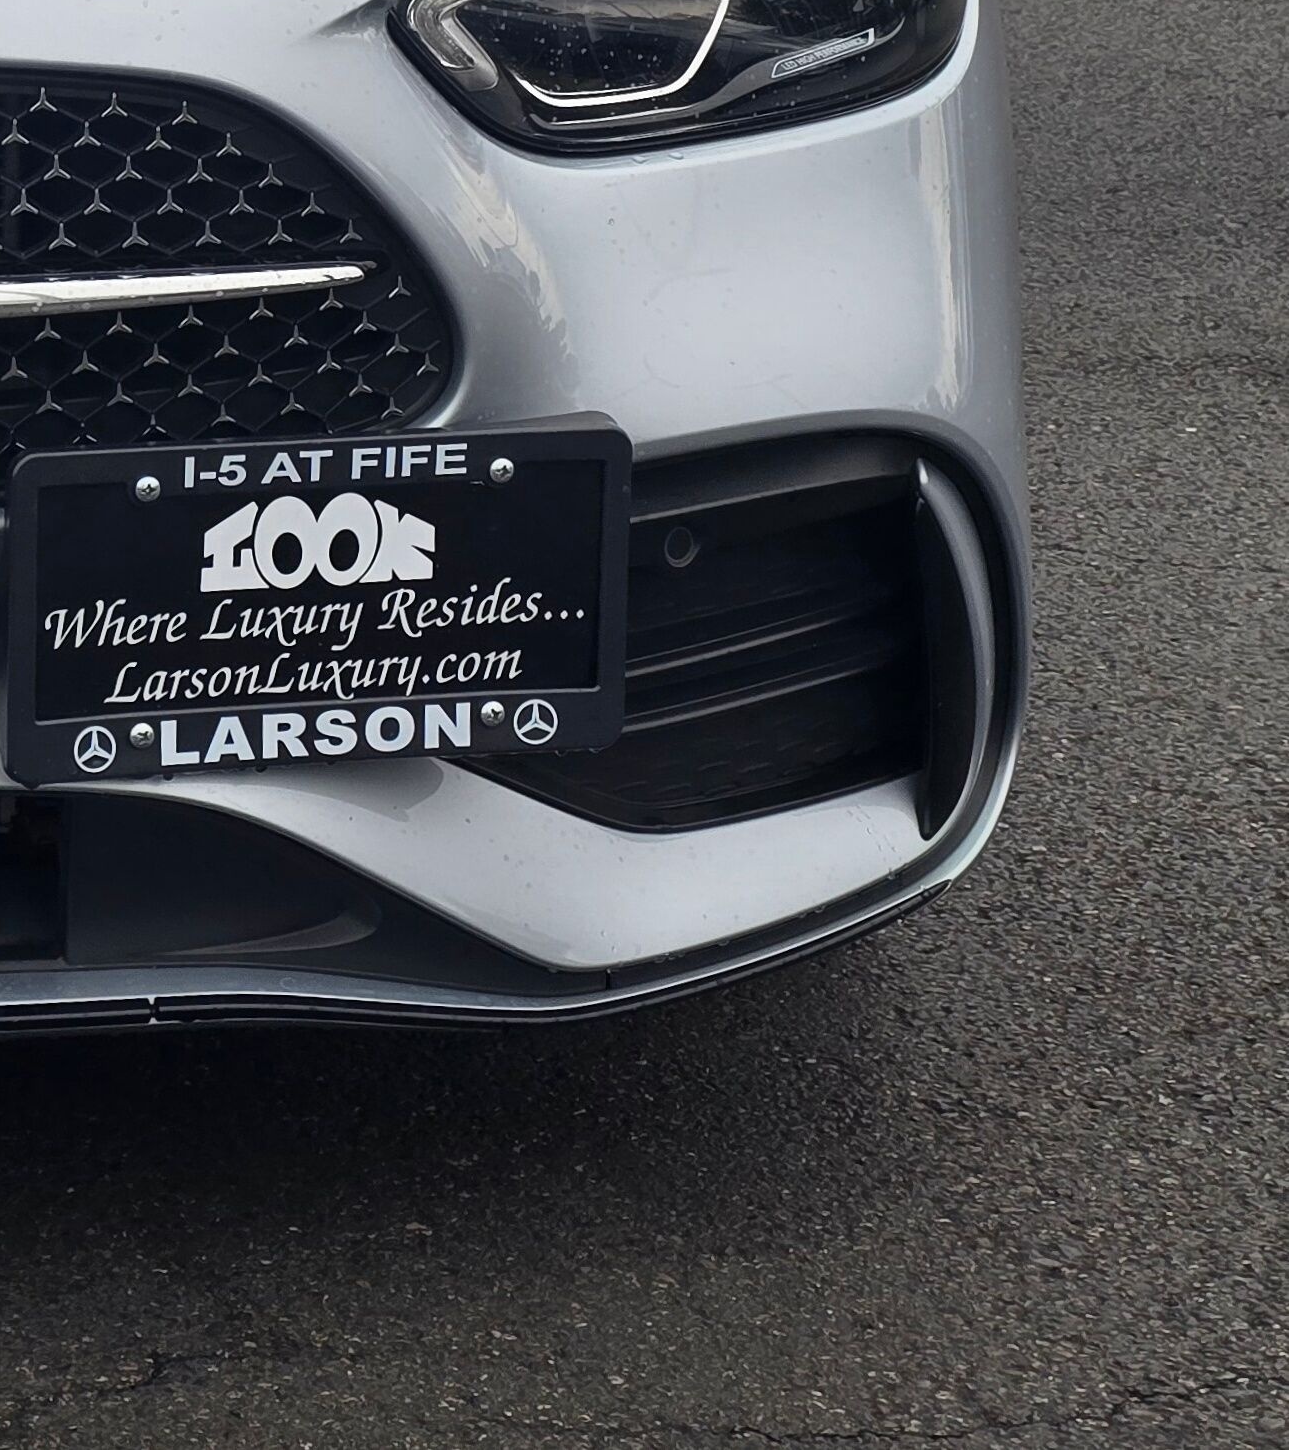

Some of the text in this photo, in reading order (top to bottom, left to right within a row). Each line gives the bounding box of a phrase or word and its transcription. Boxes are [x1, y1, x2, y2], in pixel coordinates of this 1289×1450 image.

[183, 442, 468, 488] I-5 AT FIFE
[199, 492, 436, 592] LOOK
[44, 577, 585, 651] Where Luxury Resides...
[103, 648, 523, 704] LarsonLuxury.com
[159, 701, 472, 767] LARSON
